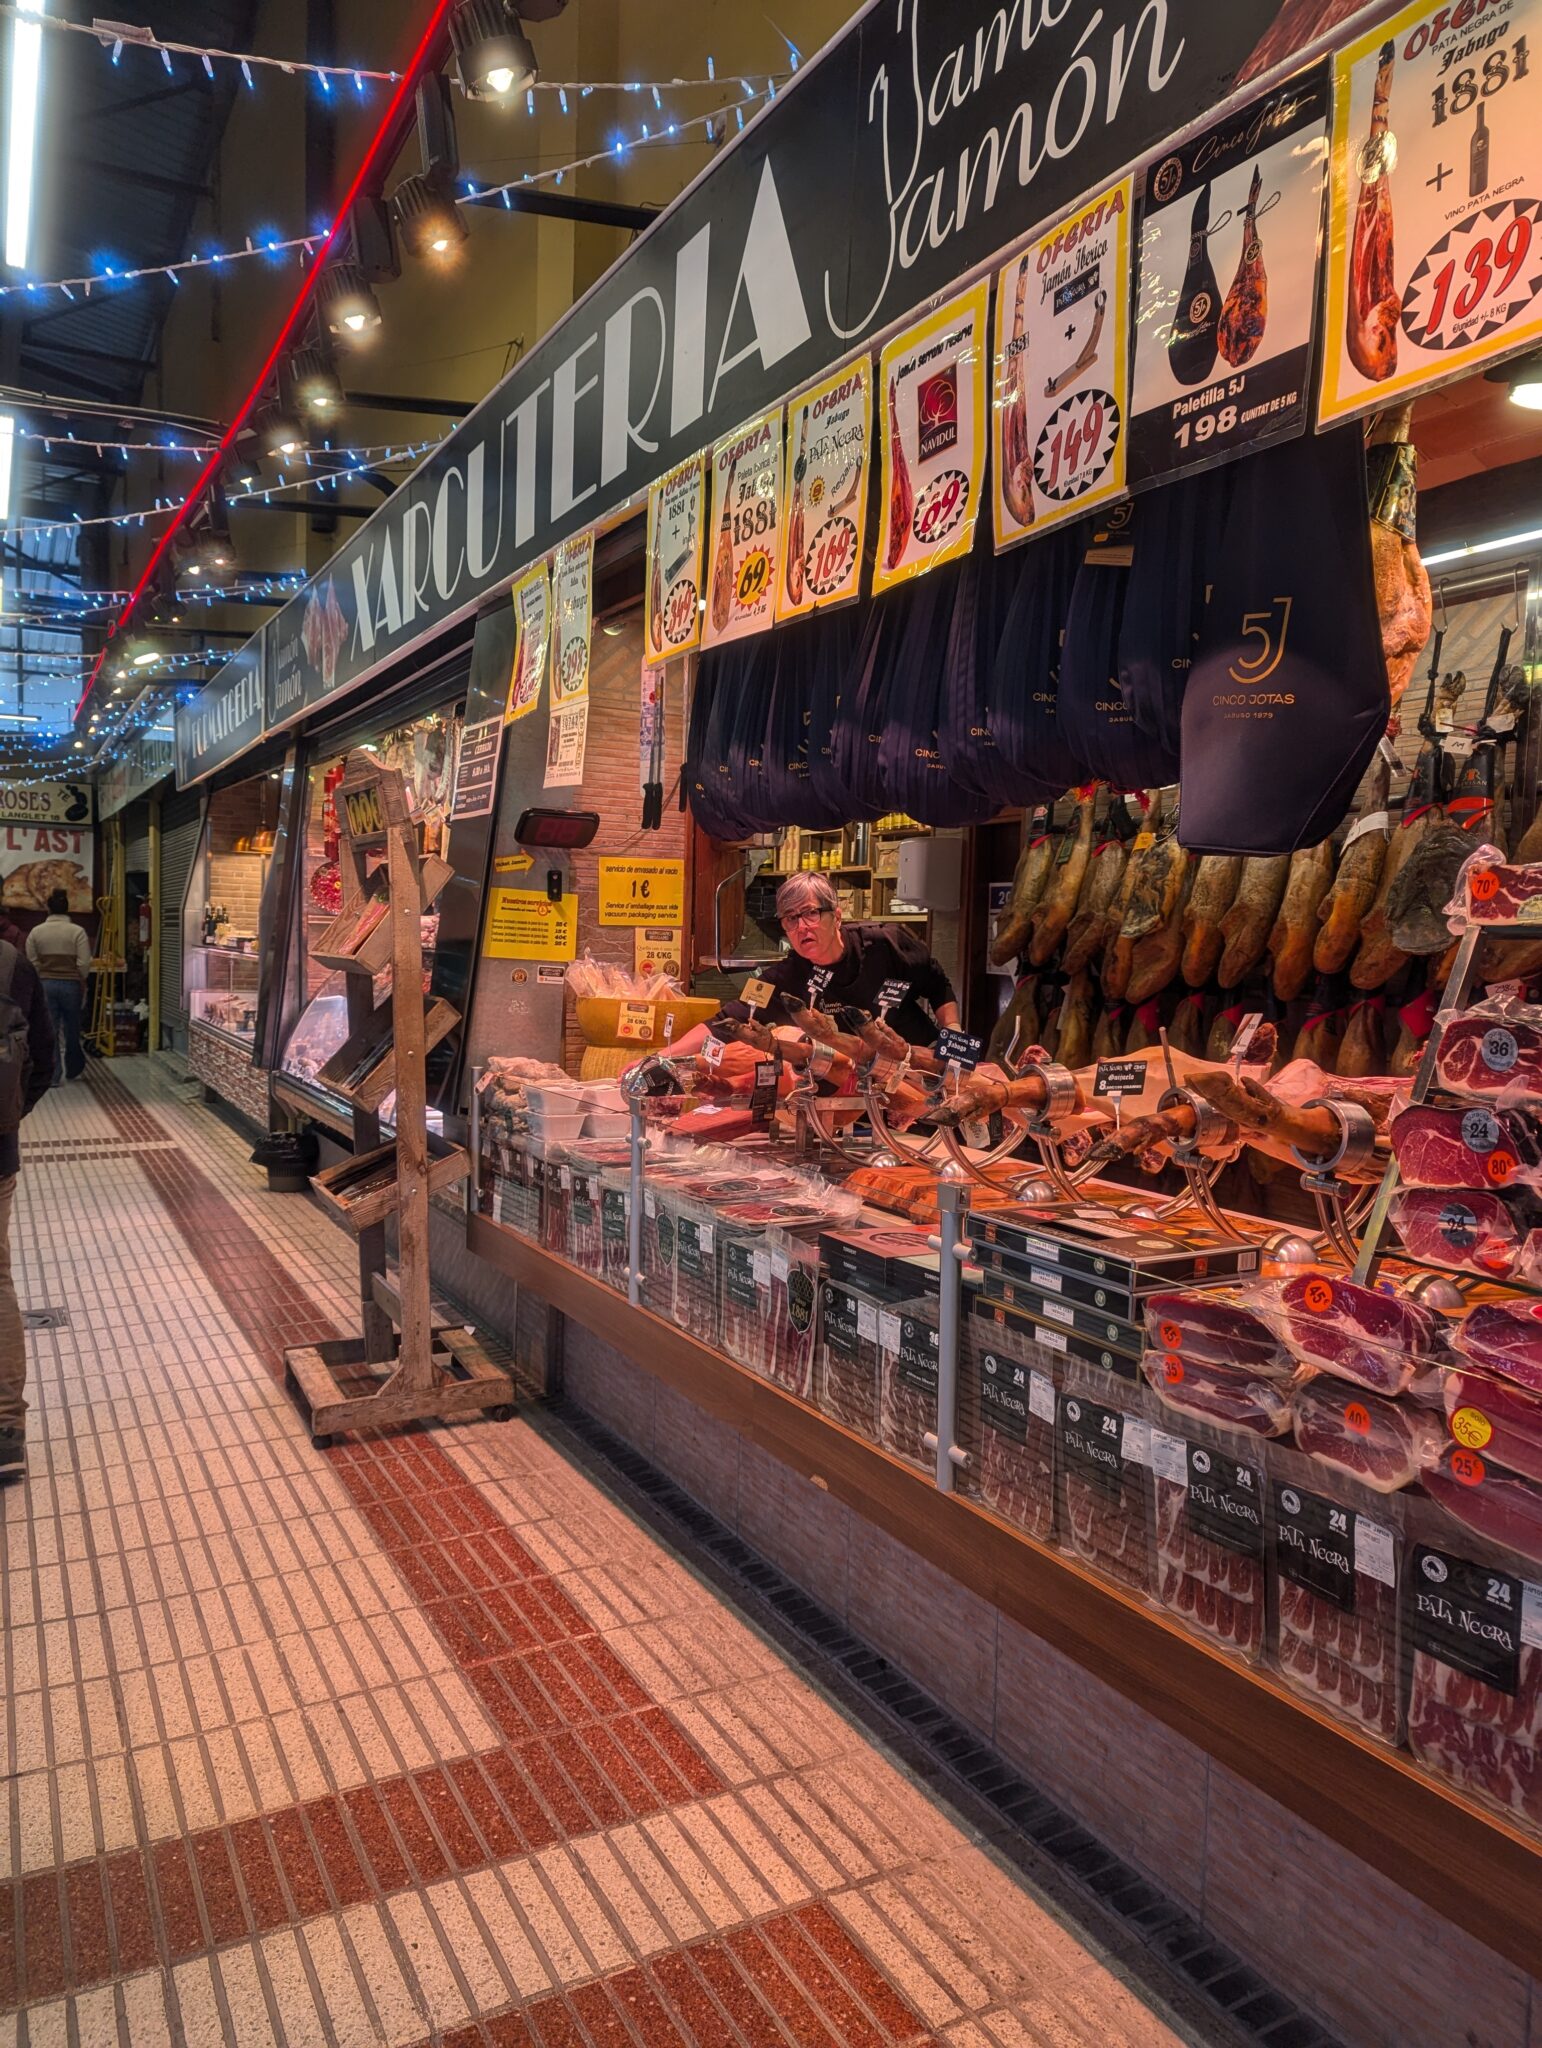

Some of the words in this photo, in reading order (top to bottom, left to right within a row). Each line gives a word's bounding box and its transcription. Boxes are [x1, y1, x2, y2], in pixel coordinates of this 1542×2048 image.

[1431, 35, 1457, 56] PATA
[1460, 13, 1497, 39] NEGRA
[1499, 2, 1514, 15] DE
[1437, 20, 1511, 77] Jabugo
[1432, 35, 1531, 128] 1881
[826, 0, 1185, 339] Jamón
[1192, 135, 1244, 173] Cinco
[1444, 205, 1466, 220] VINO
[1467, 192, 1491, 209] PATA
[1492, 175, 1525, 196] NEGRA
[1036, 189, 1126, 274] OFERTA
[1040, 260, 1072, 305] Jamón
[1426, 215, 1533, 335] 139
[1496, 303, 1507, 315] KG
[351, 154, 812, 662] XARCUTERIA
[812, 372, 863, 420] OFERTA
[1172, 387, 1225, 419] Paletilla
[1228, 375, 1246, 396] 5J
[1174, 405, 1238, 449] 198
[1270, 399, 1279, 411] DE
[1286, 391, 1297, 404] KG
[719, 423, 771, 471] OFERTA
[809, 435, 830, 464] PATA
[831, 424, 865, 452] NEGRA
[920, 426, 956, 453] NAVIDUL
[1049, 402, 1104, 489] 149
[665, 459, 702, 496] OFERTA
[668, 499, 685, 520] 1881
[733, 500, 777, 547] 1881
[813, 527, 851, 586] 169
[739, 556, 766, 599] 69
[668, 588, 692, 635] 349
[1212, 694, 1246, 706] CINCO
[1249, 693, 1296, 705] JOTAS
[605, 864, 625, 872] servicio
[627, 864, 633, 872] de
[632, 880, 637, 898] 1
[640, 879, 650, 898] €
[1476, 879, 1497, 894] 70€
[628, 911, 656, 919] packaging
[646, 951, 654, 959] 28
[939, 1046, 947, 1056] 9
[969, 1038, 981, 1048] 36
[1489, 1040, 1509, 1057] 36
[1099, 1081, 1107, 1090] 8
[1470, 1122, 1489, 1139] 24
[1491, 1158, 1513, 1176] 80€
[1447, 1217, 1466, 1233] 24
[791, 1302, 809, 1322] 1881
[1308, 1285, 1330, 1305] 45€
[1013, 1368, 1025, 1384] 24
[982, 1382, 999, 1403] PATA
[1000, 1391, 1026, 1416] NEGRA
[1102, 1416, 1117, 1434] 24
[1453, 1416, 1482, 1446] 35€
[1064, 1430, 1084, 1452] PATA
[1086, 1440, 1119, 1469] NEGRA
[1236, 1466, 1252, 1486] 24
[1455, 1456, 1479, 1478] 25€
[1190, 1484, 1217, 1508] PATA
[1219, 1495, 1260, 1525] NEGRA
[1329, 1509, 1347, 1532] 24
[1278, 1525, 1306, 1553] PATA
[1309, 1539, 1350, 1575] NEGRA
[1486, 1578, 1512, 1603] 24
[1416, 1593, 1453, 1625] PATA
[1458, 1610, 1515, 1651] NEGRA
